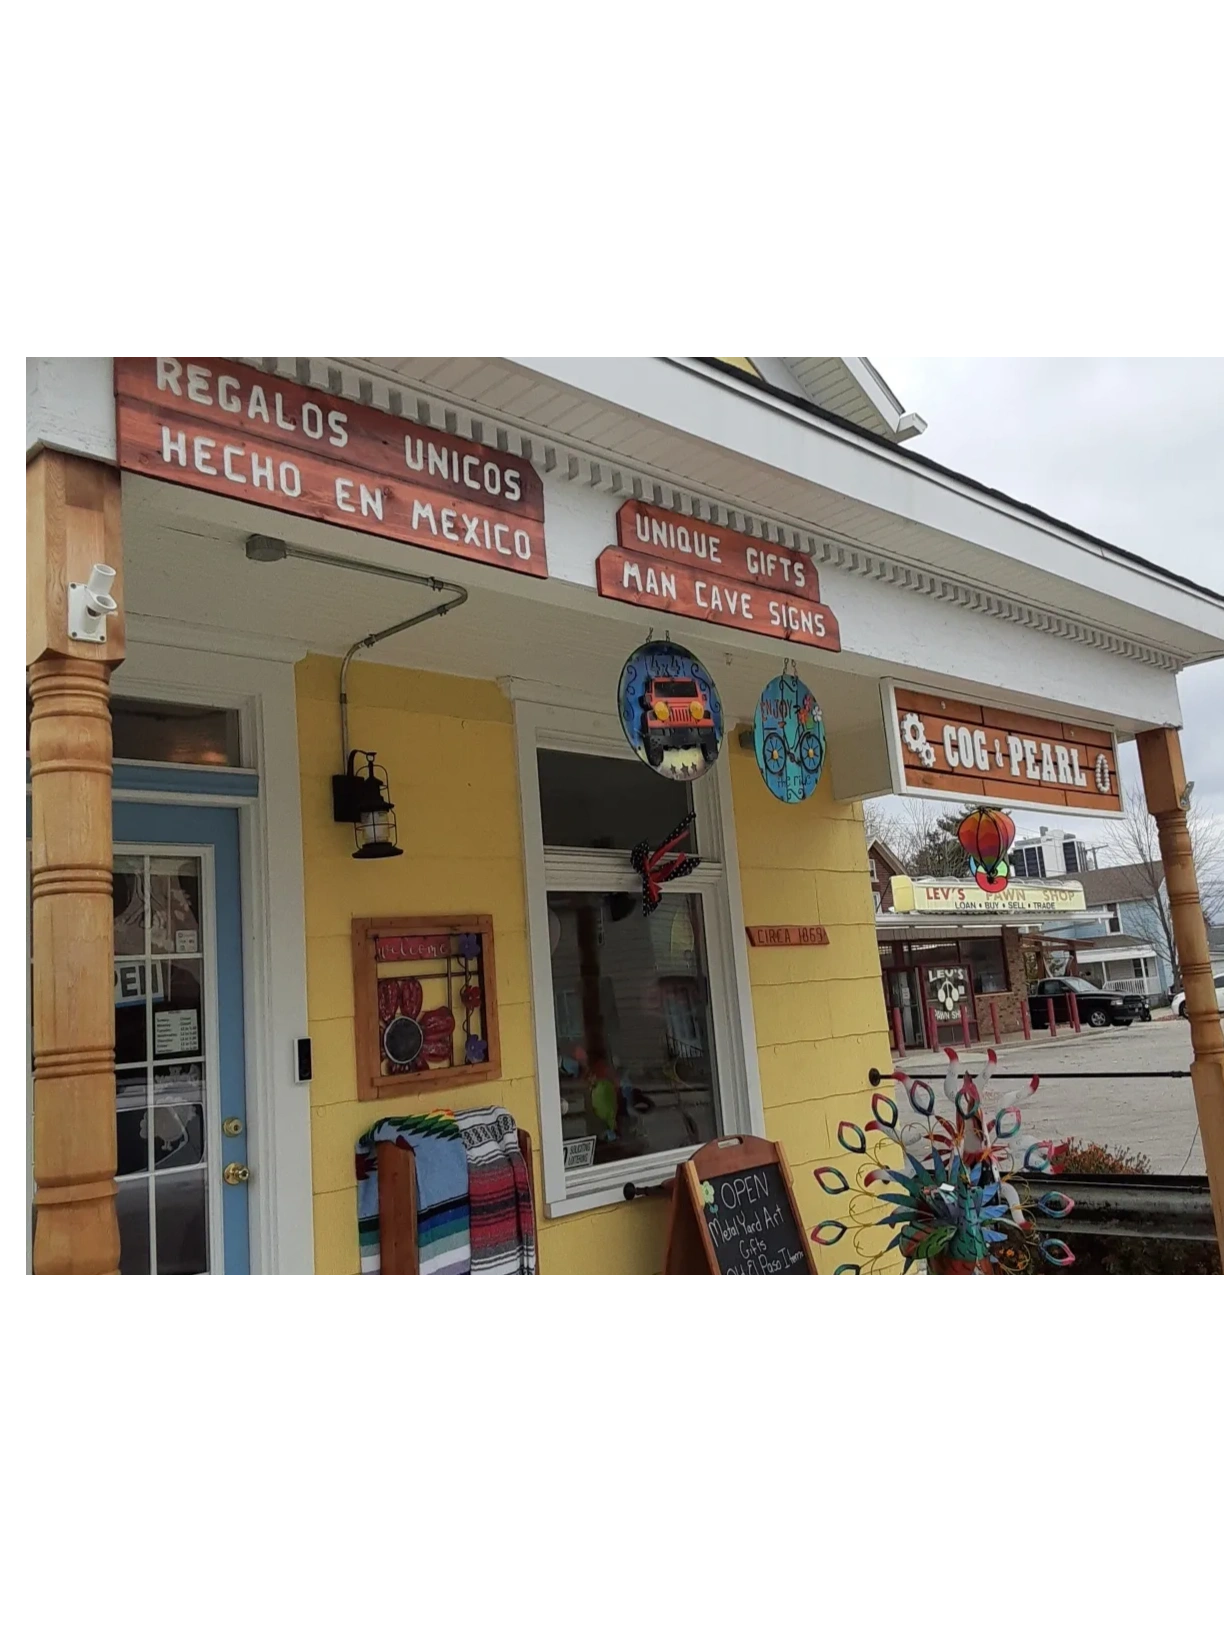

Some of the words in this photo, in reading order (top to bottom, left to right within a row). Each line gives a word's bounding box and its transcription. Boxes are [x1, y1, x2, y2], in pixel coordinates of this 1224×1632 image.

[156, 357, 348, 448] REGALOS
[405, 435, 521, 501] UNICOS
[162, 426, 301, 498] HECHO
[335, 477, 384, 520] EN
[411, 500, 531, 560] MEXICO
[635, 513, 722, 564] UNIQUE
[746, 547, 806, 588] GIFTS
[622, 561, 676, 600] MAN
[695, 582, 753, 619] CAVE
[769, 601, 826, 637] SIGNS
[760, 698, 793, 722] ENJOY
[943, 724, 990, 771] COG
[994, 738, 1004, 767] &
[1007, 735, 1087, 787] PEARL
[926, 887, 965, 901] LEV'S
[1043, 889, 1075, 902] SHOP
[955, 901, 976, 909] LOAN
[985, 902, 999, 910] BUY
[1008, 902, 1026, 910] SELL
[1033, 902, 1056, 910] TRADE
[757, 928, 791, 944] CIRCA
[928, 969, 964, 983] LEV'S
[720, 1172, 769, 1209] OPEN
[708, 1218, 740, 1248] Metal
[736, 1210, 762, 1235] Yard
[763, 1204, 785, 1229] Art
[739, 1237, 767, 1259] Gifts
[758, 1254, 782, 1276] Paso
